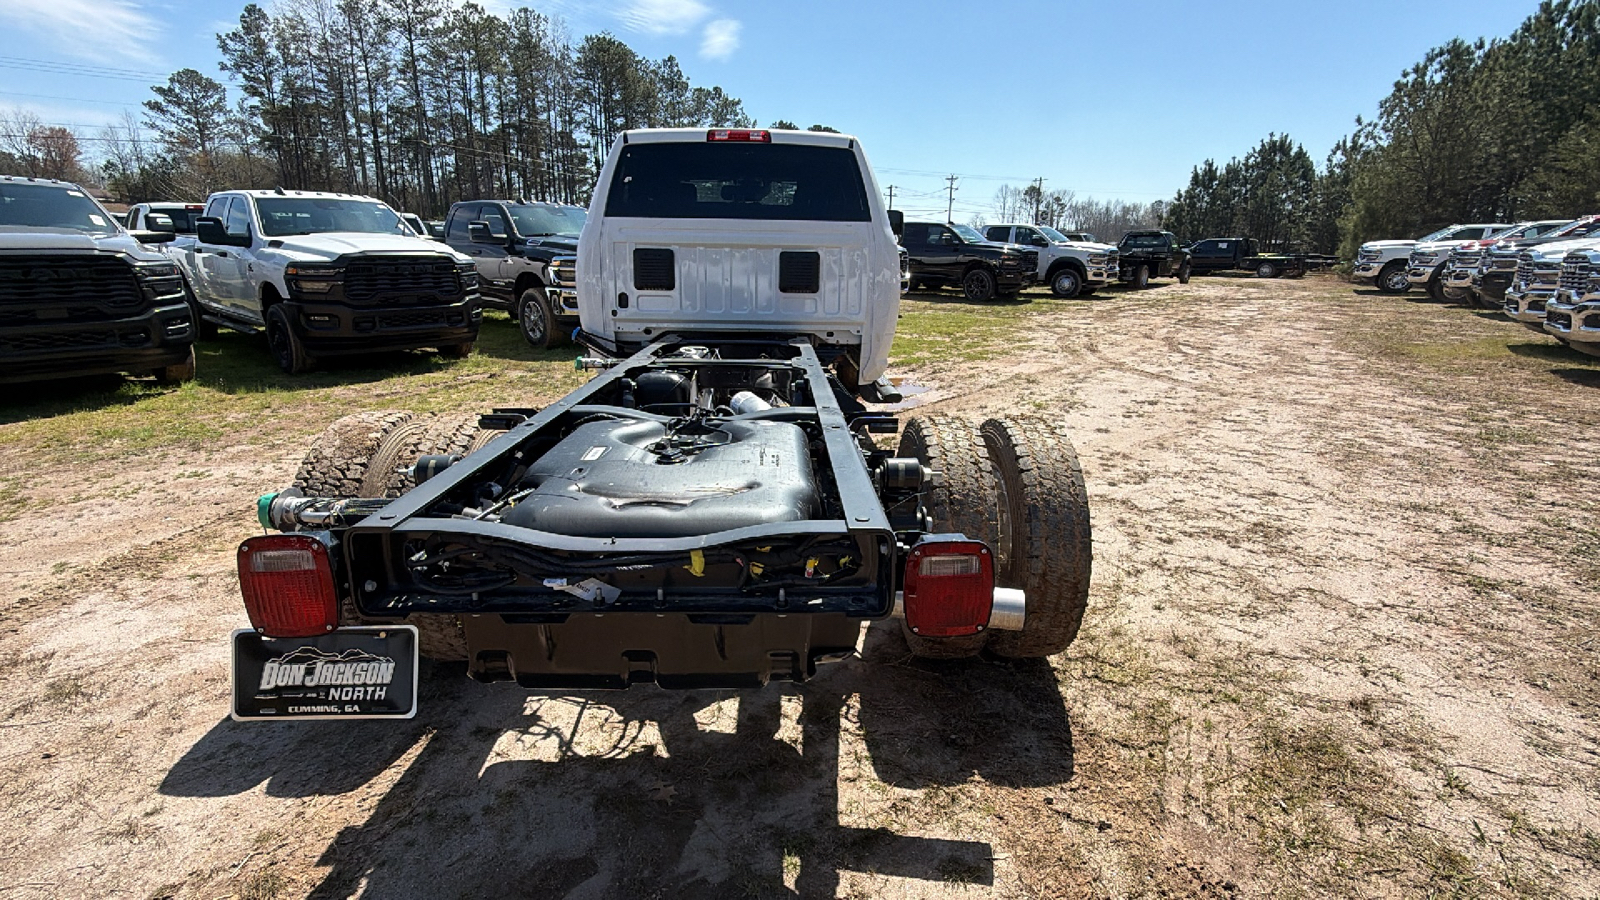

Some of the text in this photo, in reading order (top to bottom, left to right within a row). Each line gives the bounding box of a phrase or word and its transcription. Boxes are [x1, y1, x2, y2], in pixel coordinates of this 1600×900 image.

[259, 661, 396, 690] DON JACKSON
[328, 687, 387, 701] NORTH
[287, 704, 361, 714] CUMMING, GA
